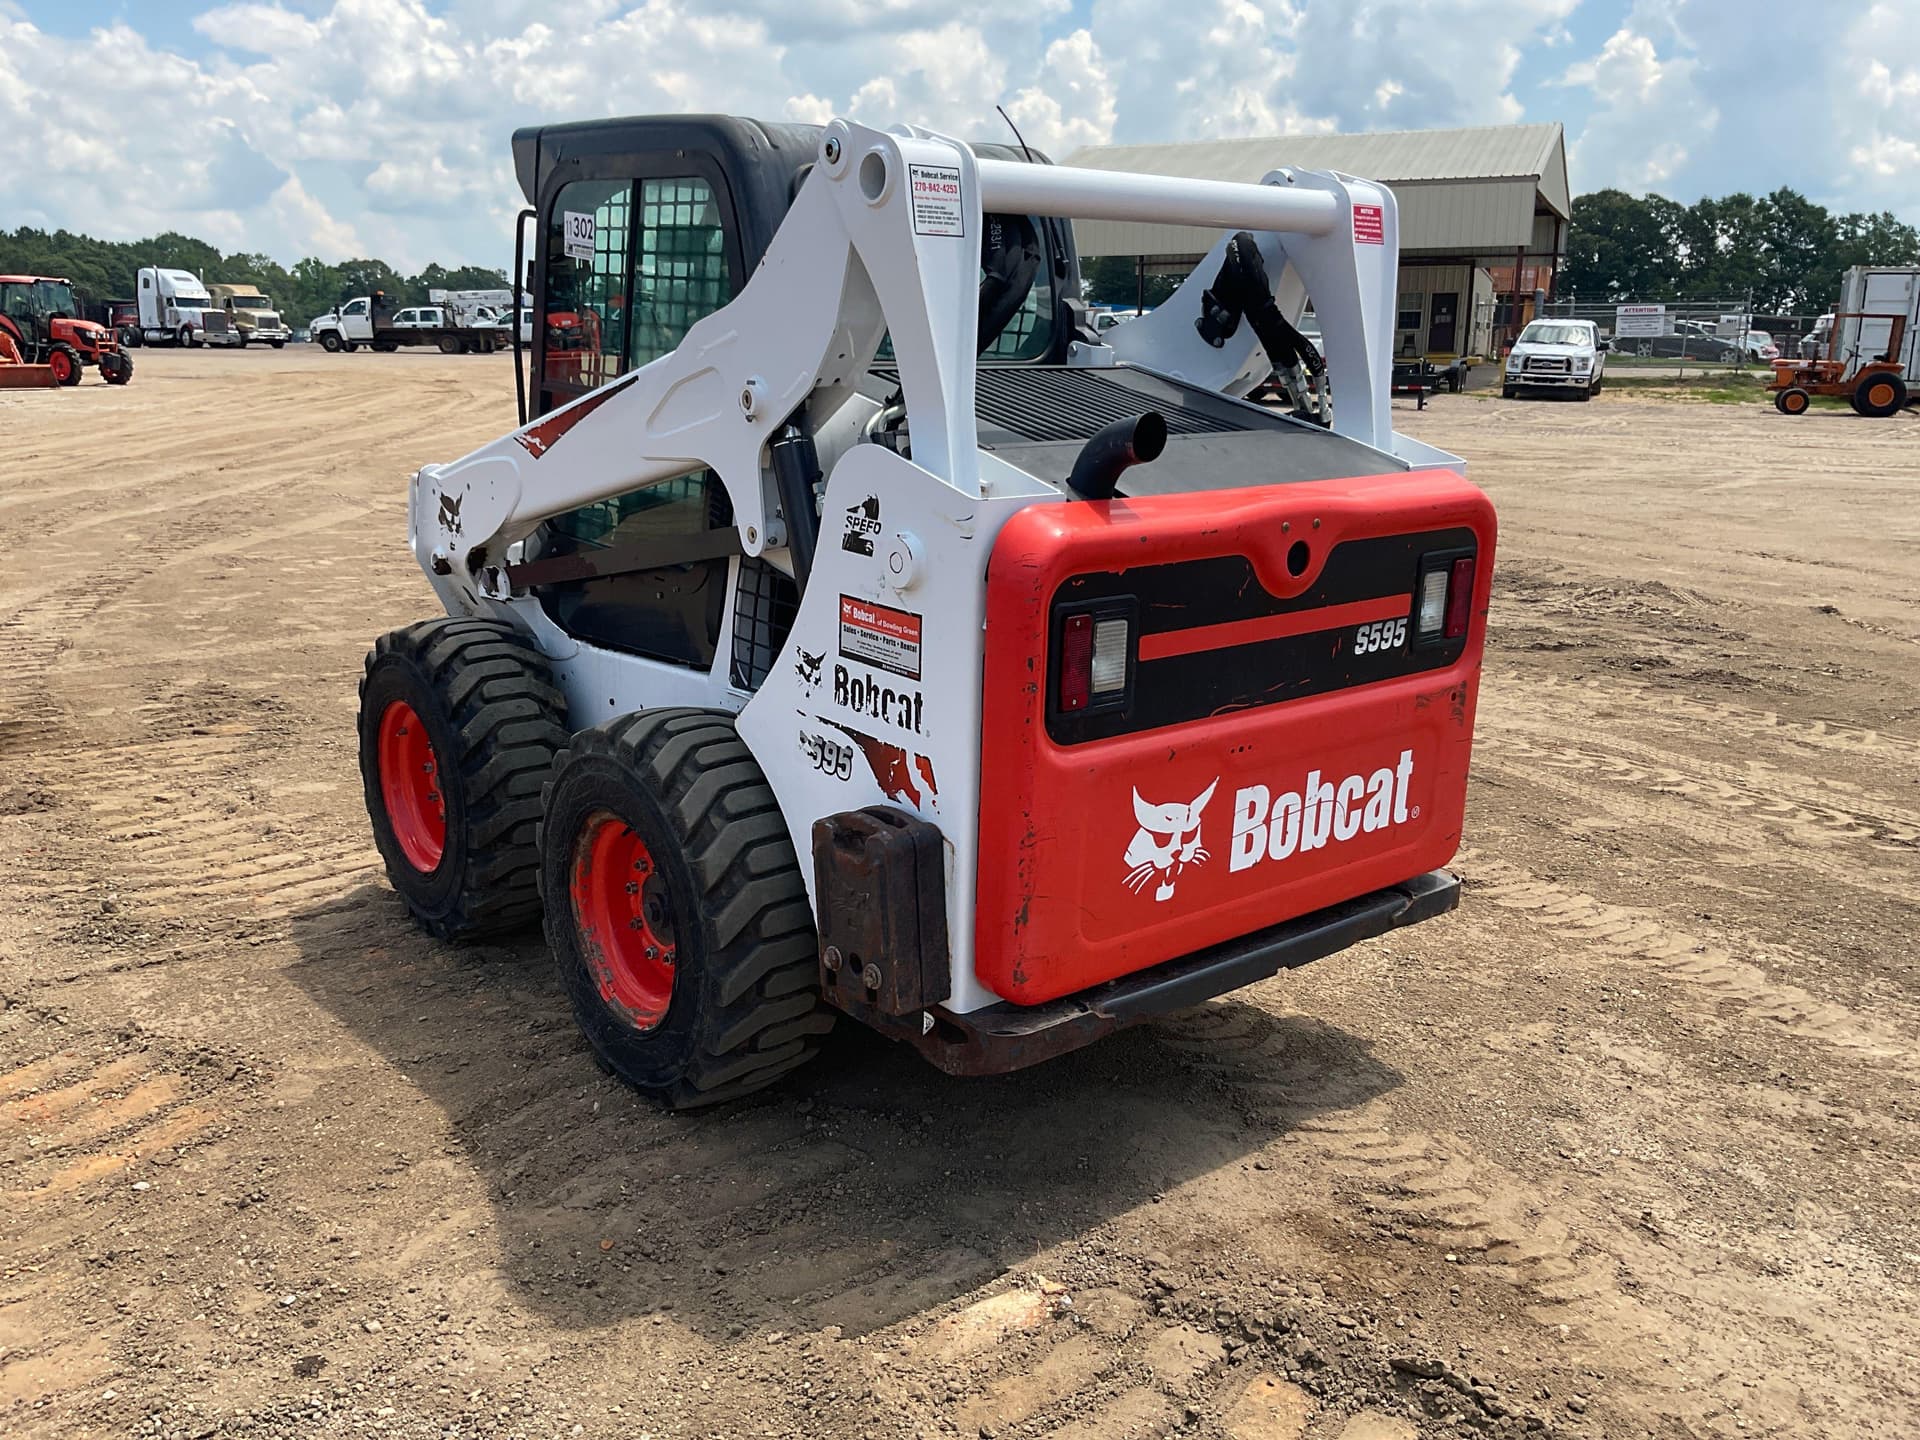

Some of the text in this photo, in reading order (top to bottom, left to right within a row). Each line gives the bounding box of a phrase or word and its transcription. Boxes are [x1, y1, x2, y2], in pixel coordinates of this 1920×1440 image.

[914, 181, 957, 194] 270-842-4253
[921, 170, 958, 181] Bobcat Service
[573, 216, 593, 240] 302
[853, 607, 876, 625] Bobcat
[883, 620, 902, 634] Bowling
[903, 625, 918, 637] Green
[1354, 618, 1408, 655] S595
[843, 624, 857, 635] Sales
[860, 629, 879, 642] Service
[883, 636, 896, 647] Parts
[900, 641, 917, 653] Rental
[834, 663, 923, 734] Bobcat
[800, 731, 853, 781] 595
[1229, 749, 1414, 873] Bobcat
